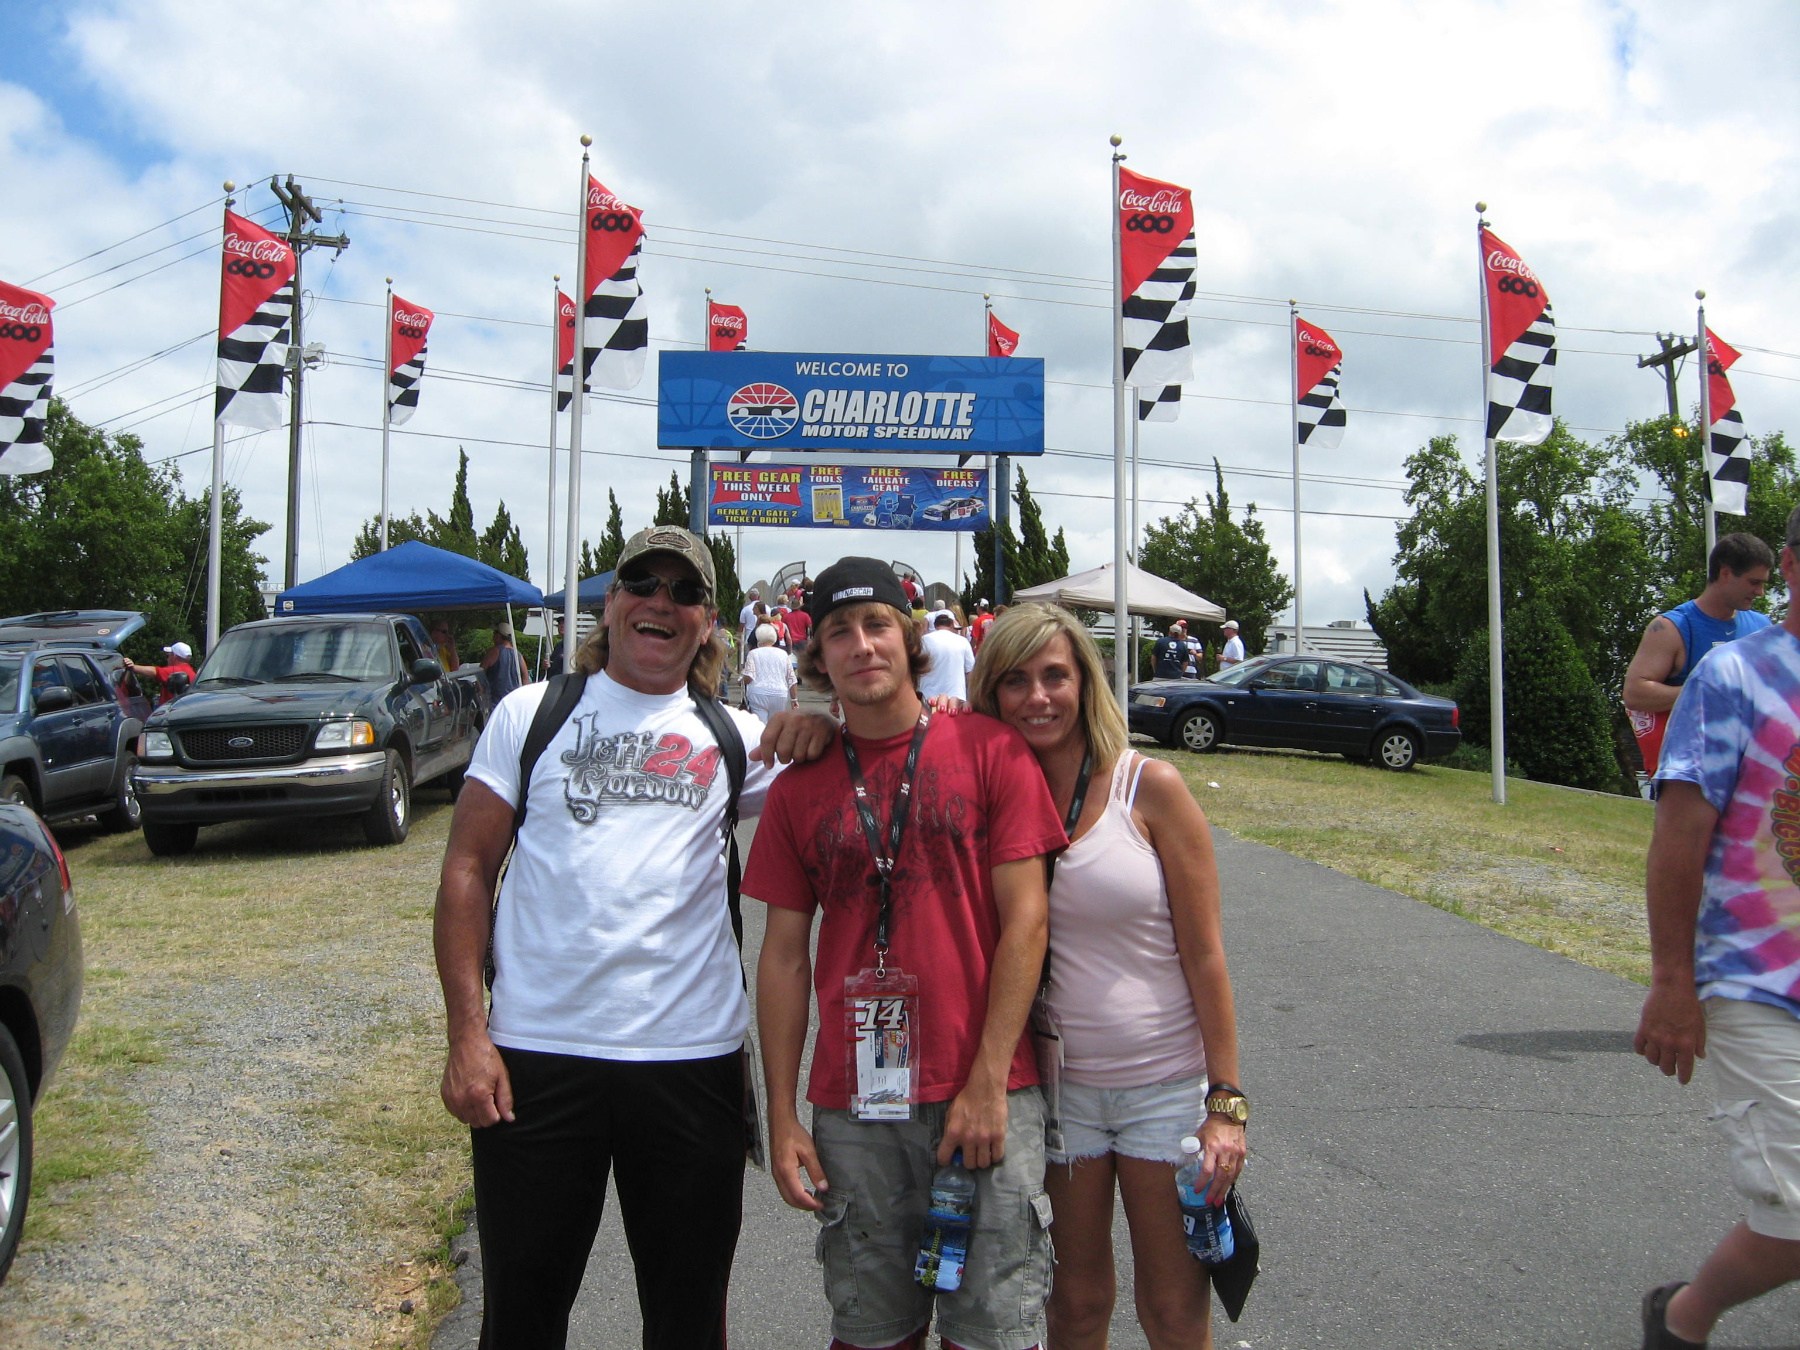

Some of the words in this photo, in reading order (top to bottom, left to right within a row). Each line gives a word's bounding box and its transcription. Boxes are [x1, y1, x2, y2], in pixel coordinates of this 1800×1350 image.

[1120, 189, 1183, 213] Coca-Cola
[591, 212, 634, 232] 600
[1126, 214, 1174, 233] 600
[223, 233, 288, 262] Coca-Cola
[227, 260, 276, 279] 600
[1498, 276, 1538, 298] 600
[395, 310, 430, 327] Coca-Cola
[711, 314, 744, 329] Coca-Cola
[0, 323, 42, 342] 600
[795, 361, 881, 377] WELCOME
[886, 363, 909, 378] TO
[801, 388, 977, 427] CHARLOTTE
[801, 424, 870, 438] MOTOR
[873, 425, 974, 441] SPEEDWAY
[713, 471, 752, 482] FREE
[758, 472, 801, 483] GEAR
[809, 475, 843, 483] TOOLS
[811, 466, 842, 475] FREE
[871, 468, 901, 477] FREE
[943, 470, 974, 480] FREE
[723, 482, 752, 492] THIS
[756, 483, 791, 493] WEEK
[862, 476, 911, 485] TAILGATE
[872, 484, 900, 492] GEAR
[936, 479, 980, 488] DIECAST
[741, 492, 773, 502] ONLY
[717, 508, 748, 516] RENEW
[766, 509, 788, 517] GATE
[725, 515, 755, 523] TICKET
[760, 516, 790, 524] BOOTH
[562, 711, 655, 769] Jeff
[639, 732, 723, 788] 24
[563, 762, 708, 826] Gordon
[858, 999, 904, 1031] 14
